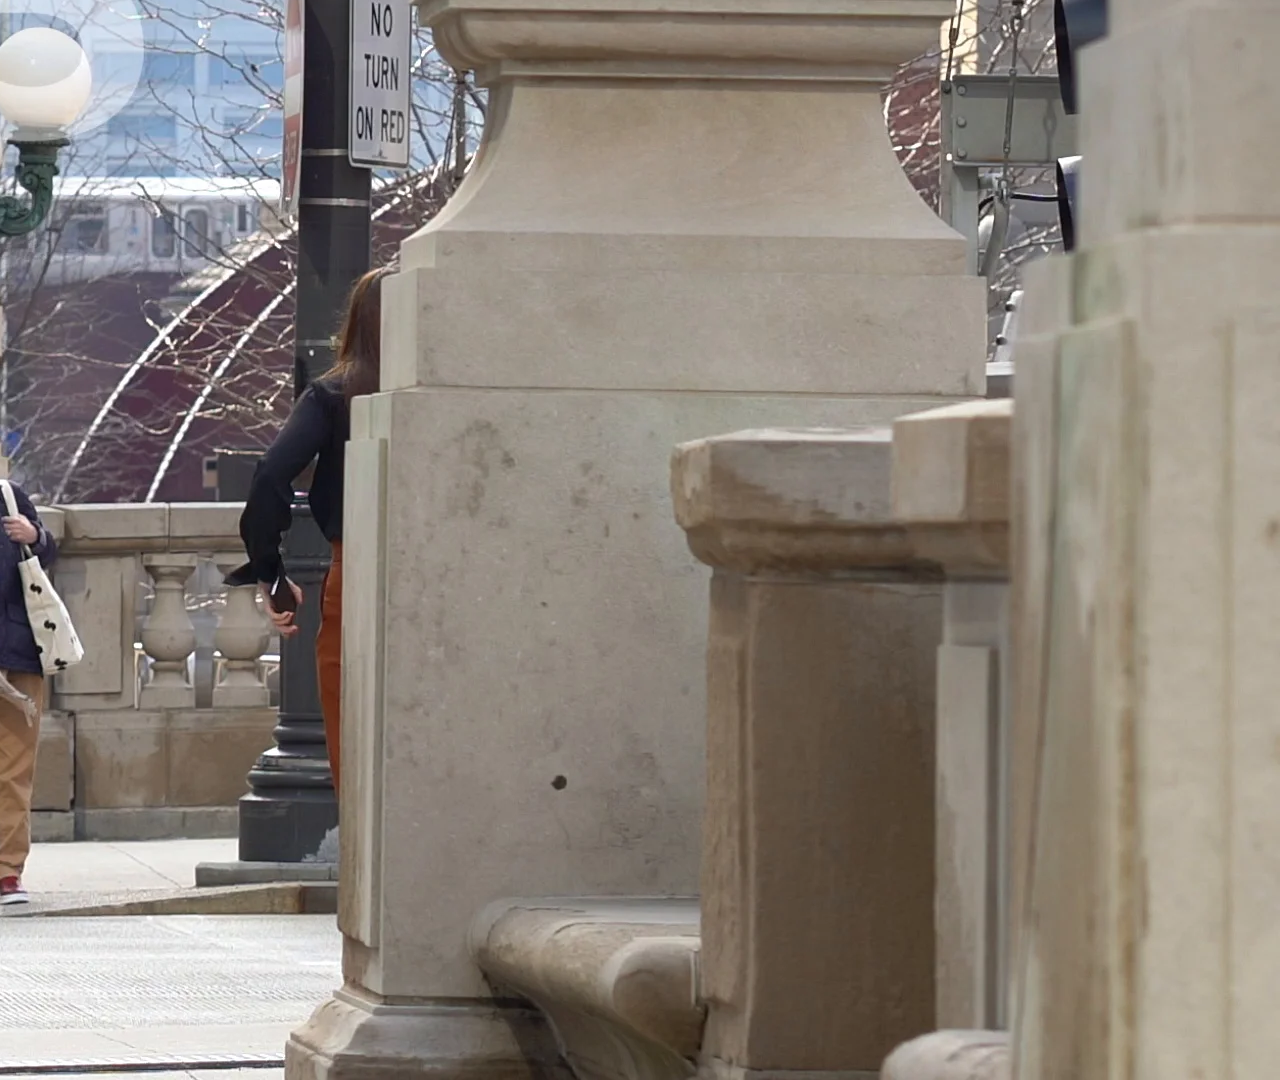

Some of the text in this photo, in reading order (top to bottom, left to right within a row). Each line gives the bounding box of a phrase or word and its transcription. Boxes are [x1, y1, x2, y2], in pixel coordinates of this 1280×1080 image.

[371, 2, 393, 38] NO
[364, 53, 399, 91] TURN
[356, 106, 405, 144] ON RED
